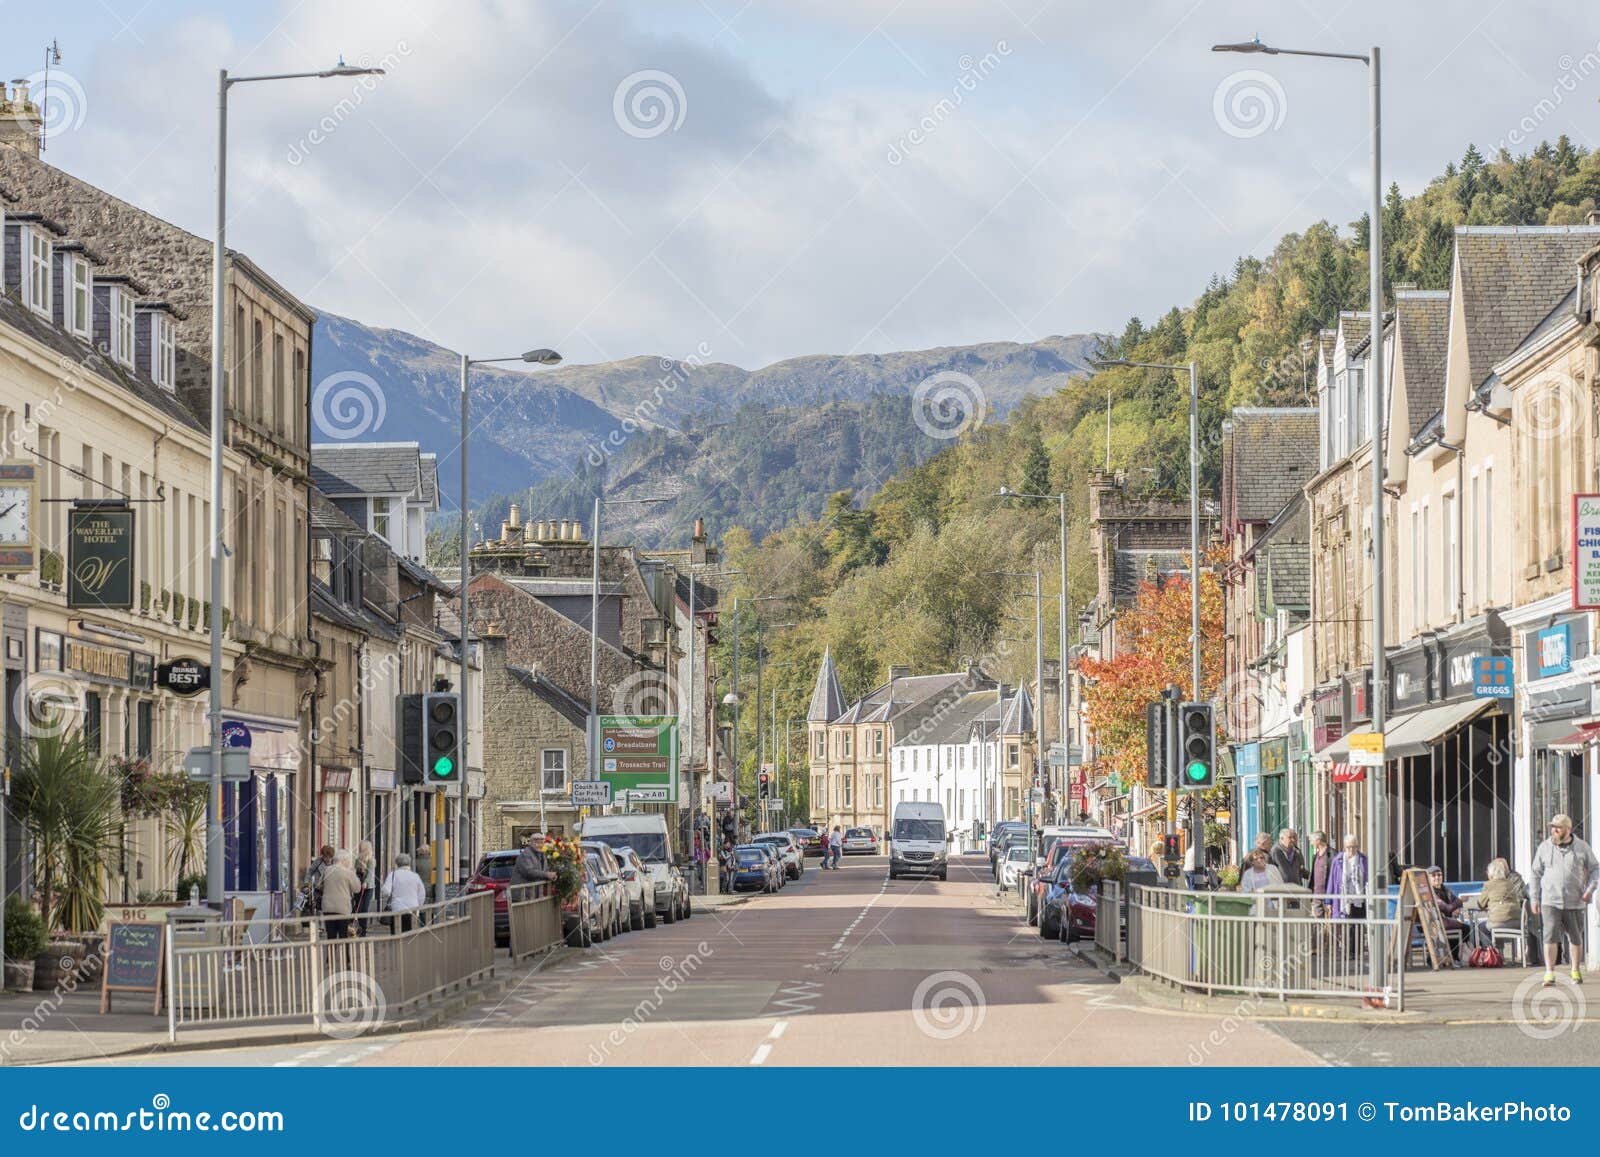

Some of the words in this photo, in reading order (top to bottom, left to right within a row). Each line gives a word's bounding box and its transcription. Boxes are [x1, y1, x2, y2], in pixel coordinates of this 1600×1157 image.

[90, 520, 110, 528] THE
[76, 528, 124, 536] WAVERLEY
[169, 673, 201, 684] BEST
[1476, 686, 1510, 695] GREGGS
[652, 761, 666, 769] Trail
[122, 909, 146, 920] BIG
